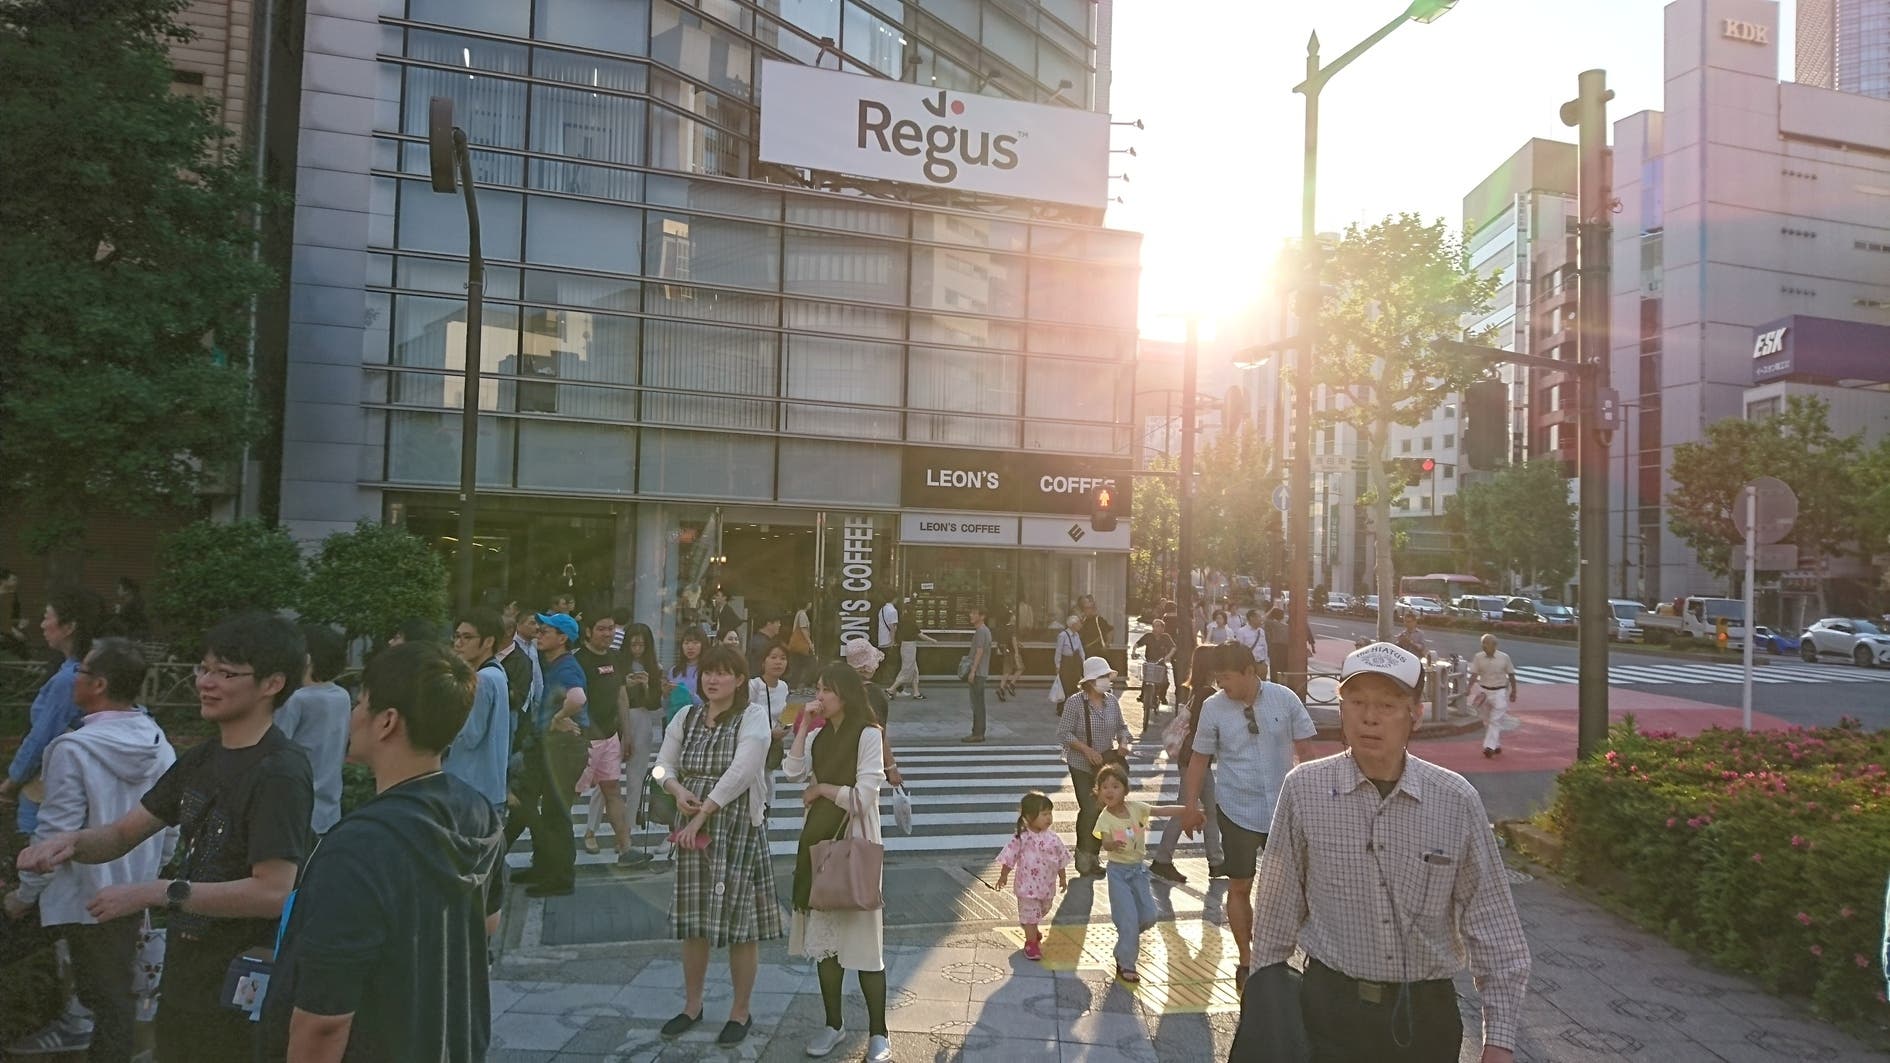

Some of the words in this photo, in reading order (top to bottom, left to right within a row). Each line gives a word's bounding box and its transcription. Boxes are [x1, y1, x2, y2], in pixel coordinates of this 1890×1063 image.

[1726, 19, 1768, 43] KDK
[857, 98, 1019, 184] Regus
[1753, 327, 1787, 359] ESK
[926, 469, 999, 489] LEON'S
[919, 522, 957, 533] LEON'S
[961, 523, 1001, 534] COFFEE
[842, 516, 873, 592] COFFEE
[1371, 646, 1408, 662] HIATUS
